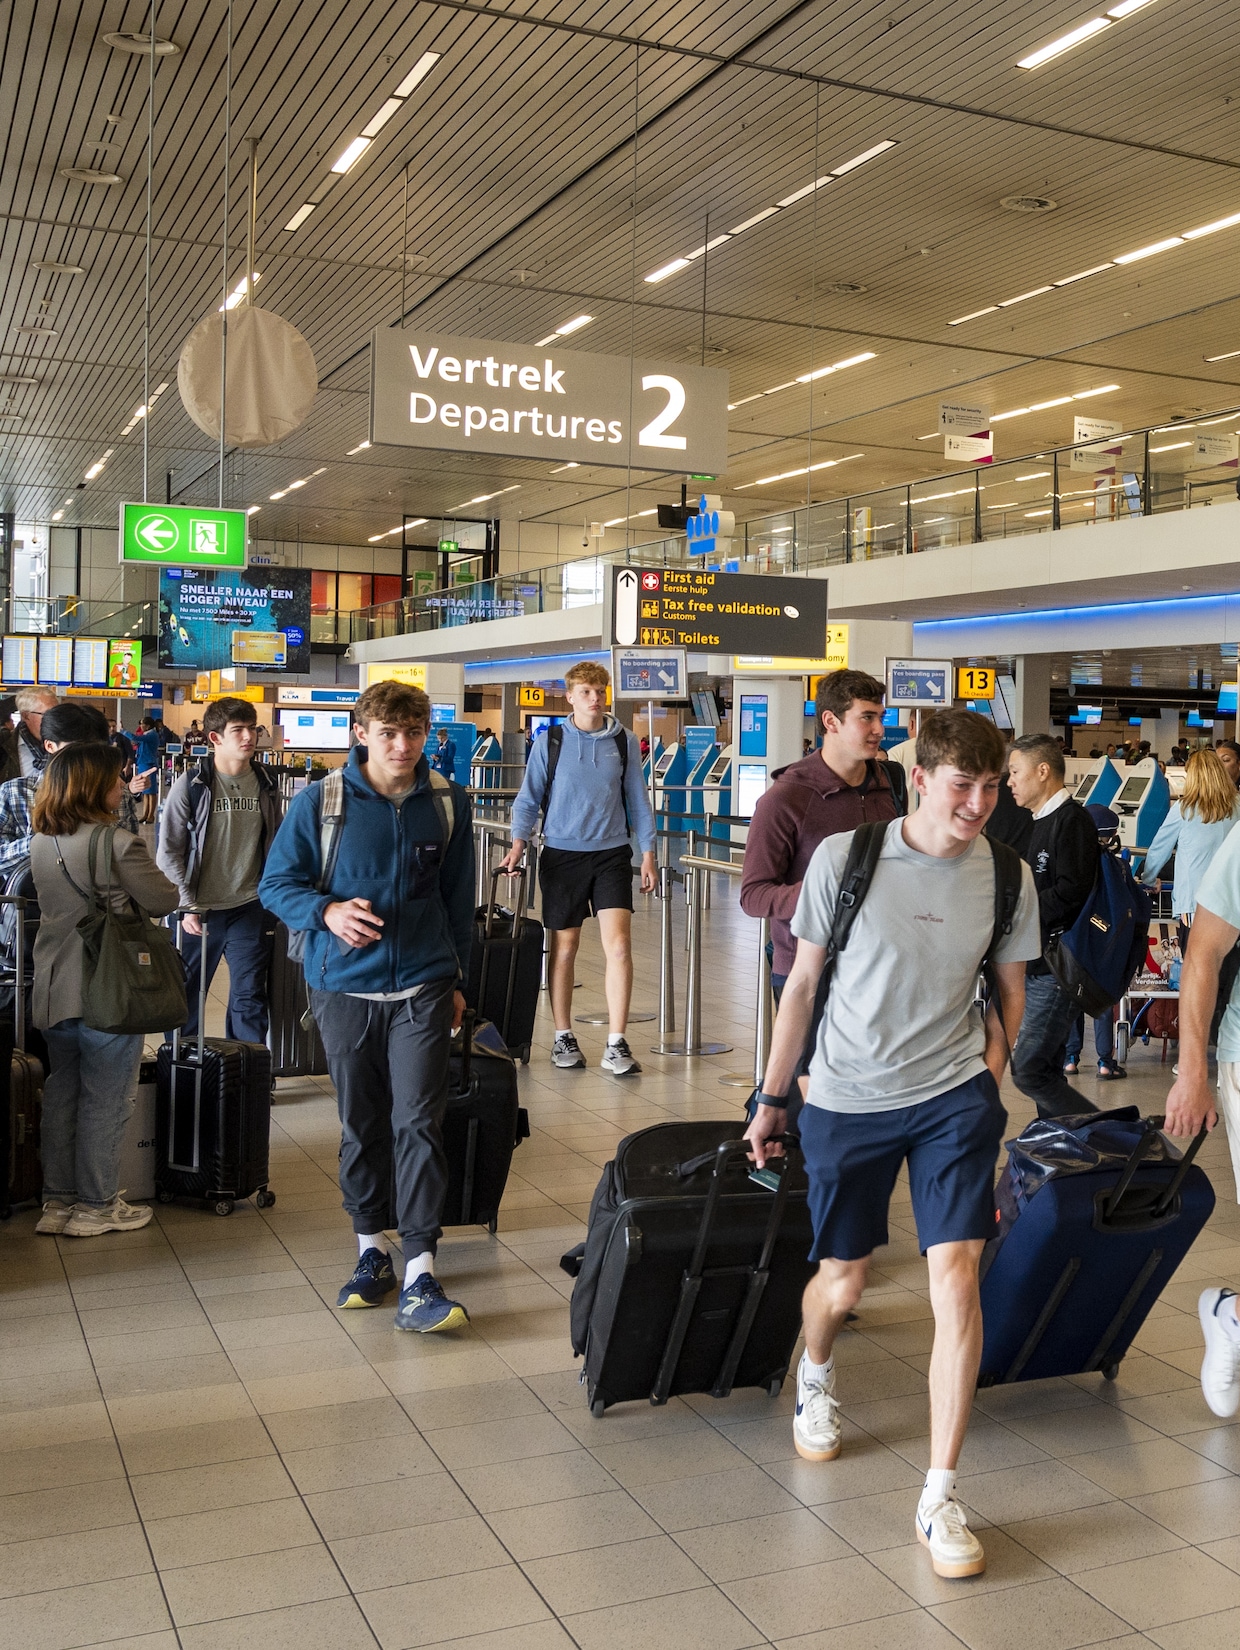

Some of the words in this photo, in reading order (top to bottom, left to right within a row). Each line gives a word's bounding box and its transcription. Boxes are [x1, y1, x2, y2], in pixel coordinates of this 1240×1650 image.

[408, 344, 567, 395] Vertrek
[408, 391, 624, 445] Departures
[638, 373, 687, 451] 2
[664, 571, 692, 584] First
[695, 573, 716, 586] aid
[180, 584, 233, 597] SNELLER
[235, 587, 268, 599] NAAR
[270, 589, 294, 600] EEN
[663, 584, 688, 593] Eerste
[689, 585, 708, 595] hulp
[180, 595, 221, 606] HOGER
[224, 597, 268, 608] NIVEAU
[663, 599, 685, 611] Tax
[688, 599, 714, 612] free
[717, 602, 781, 617] validation
[219, 608, 234, 616] Miles
[662, 612, 697, 621] Customs
[678, 631, 720, 645] Toilets
[632, 660, 661, 668] boarding
[410, 668, 418, 677] 16
[966, 670, 989, 690] 13
[524, 688, 541, 701] 16
